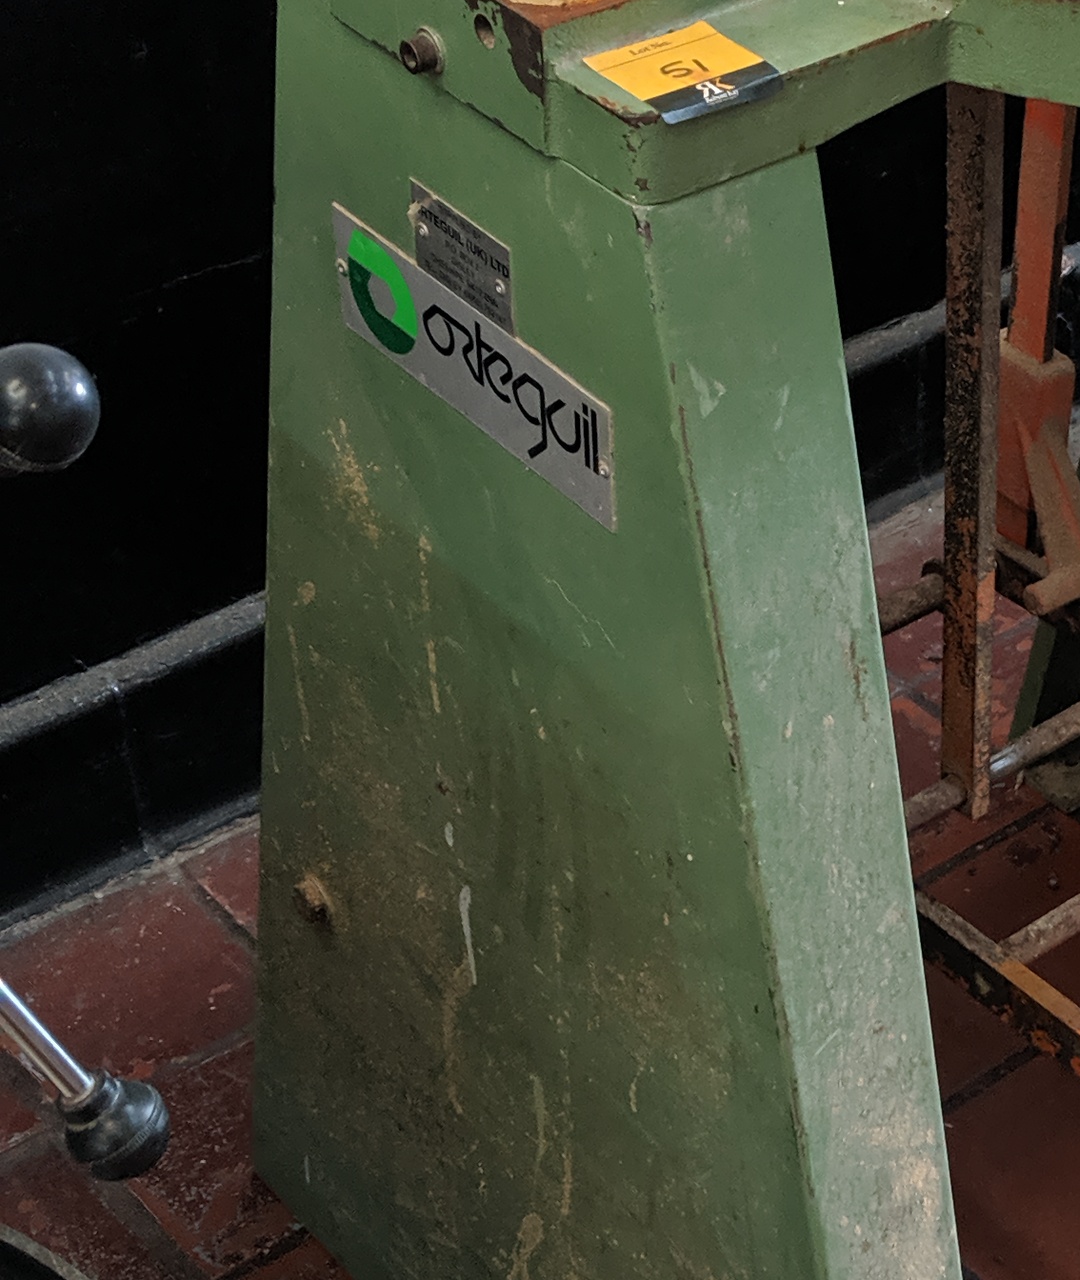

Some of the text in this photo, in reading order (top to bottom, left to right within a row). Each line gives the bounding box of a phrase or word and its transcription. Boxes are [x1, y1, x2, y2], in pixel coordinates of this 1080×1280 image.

[629, 45, 651, 56] Lot
[418, 205, 465, 248] RTEGUIL
[489, 255, 510, 279] LTD
